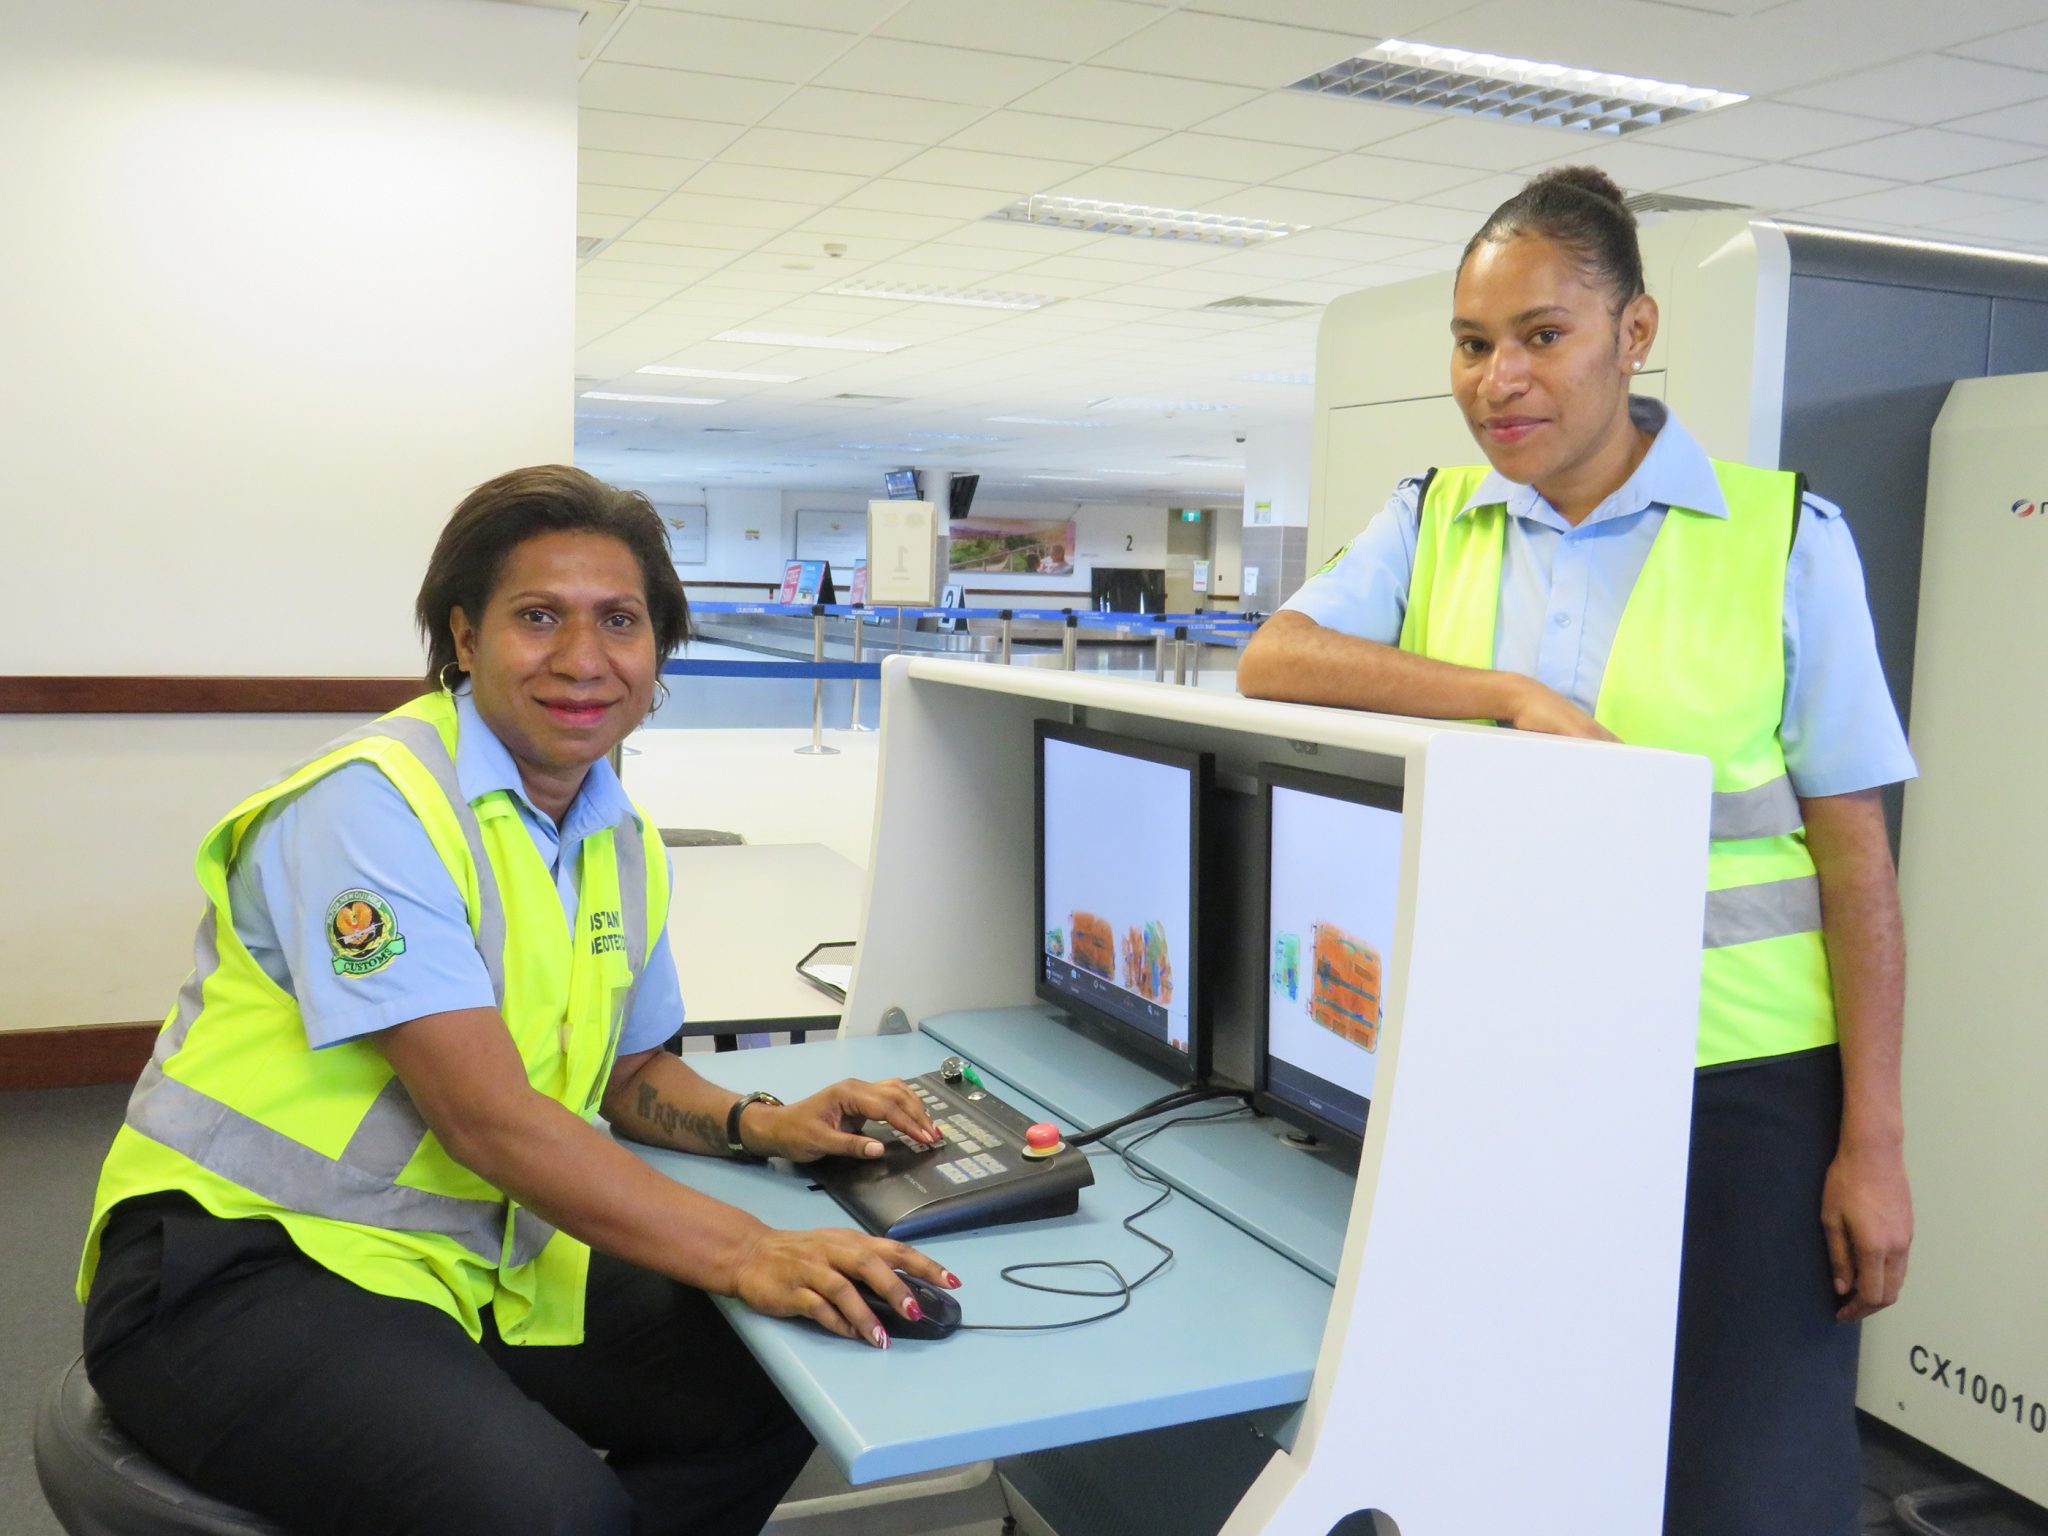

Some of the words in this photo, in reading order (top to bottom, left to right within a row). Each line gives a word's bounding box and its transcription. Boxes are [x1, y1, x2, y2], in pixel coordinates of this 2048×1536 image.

[1126, 535, 1133, 551] 2
[343, 947, 393, 972] CUSTOMS
[1909, 1344, 2047, 1434] CX10010
